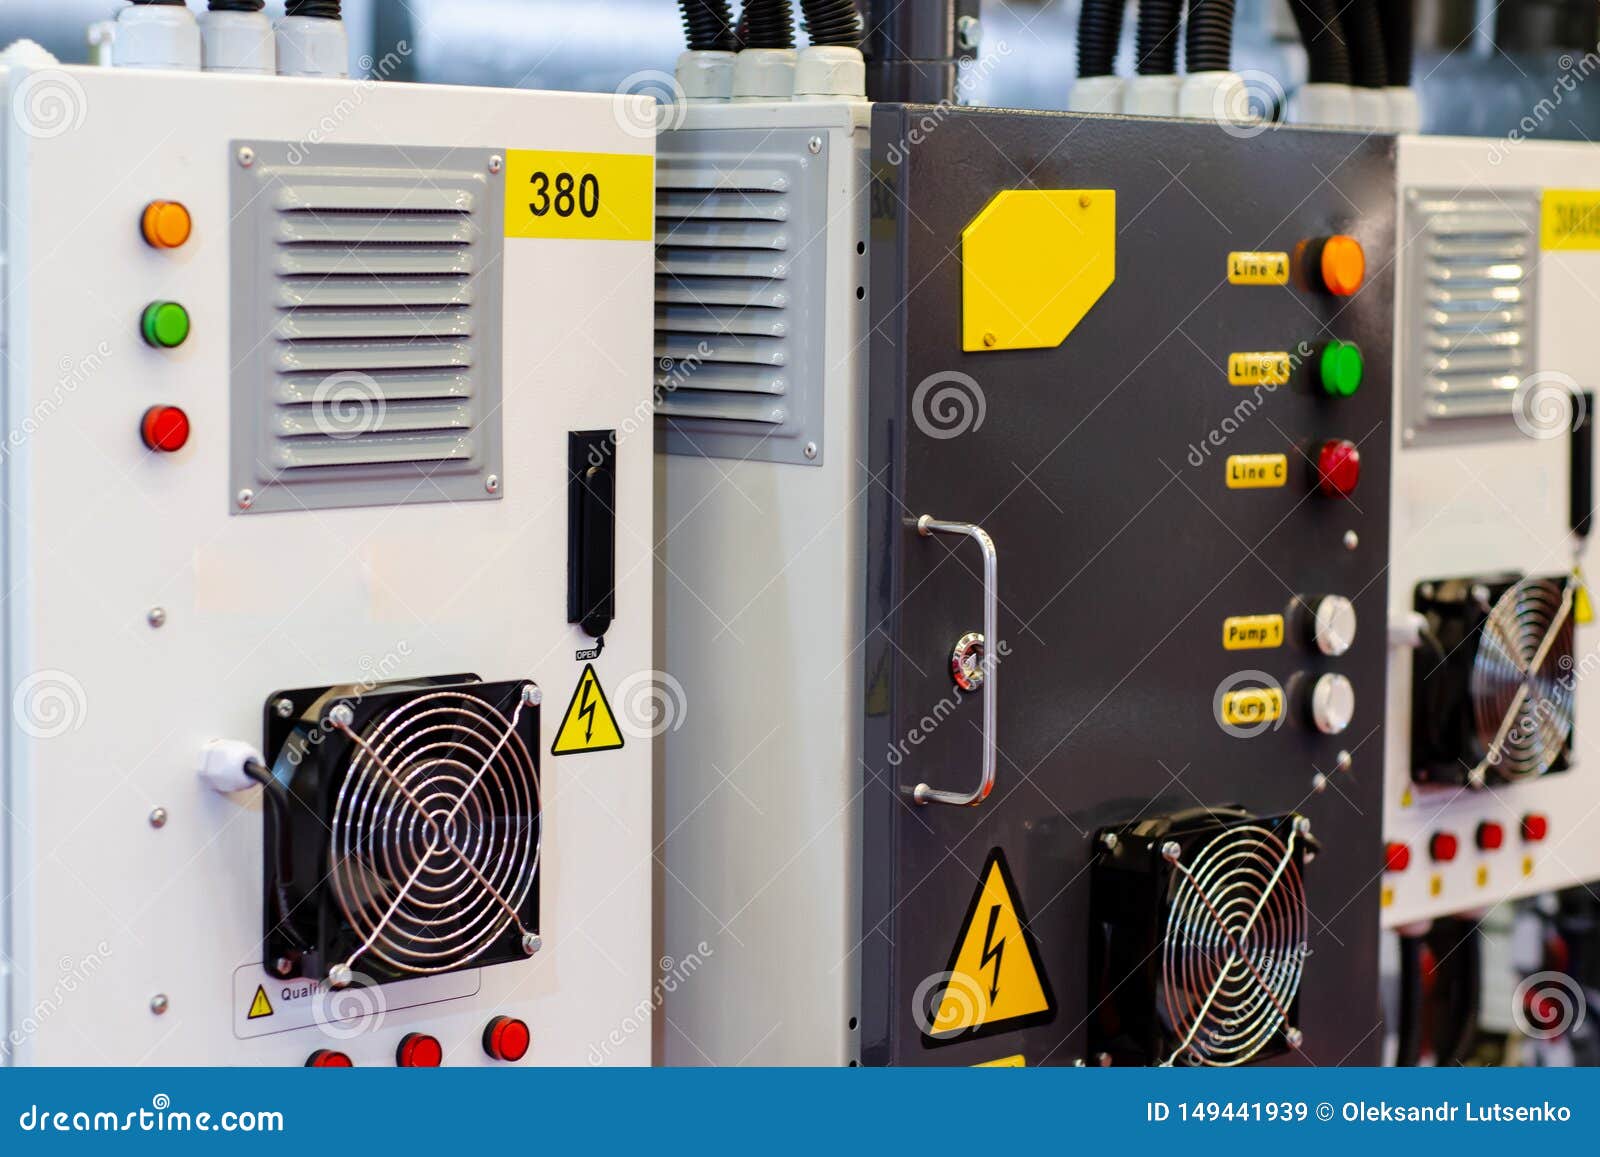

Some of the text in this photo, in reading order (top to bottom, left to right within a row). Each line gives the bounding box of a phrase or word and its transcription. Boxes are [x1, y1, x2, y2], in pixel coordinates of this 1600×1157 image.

[529, 171, 600, 218] 380
[1233, 261, 1285, 276] Line A
[1234, 361, 1268, 377] Line
[1232, 463, 1283, 479] Line C
[1229, 624, 1280, 643] Pump 1
[577, 650, 598, 660] OPEN
[1228, 699, 1266, 717] Pump
